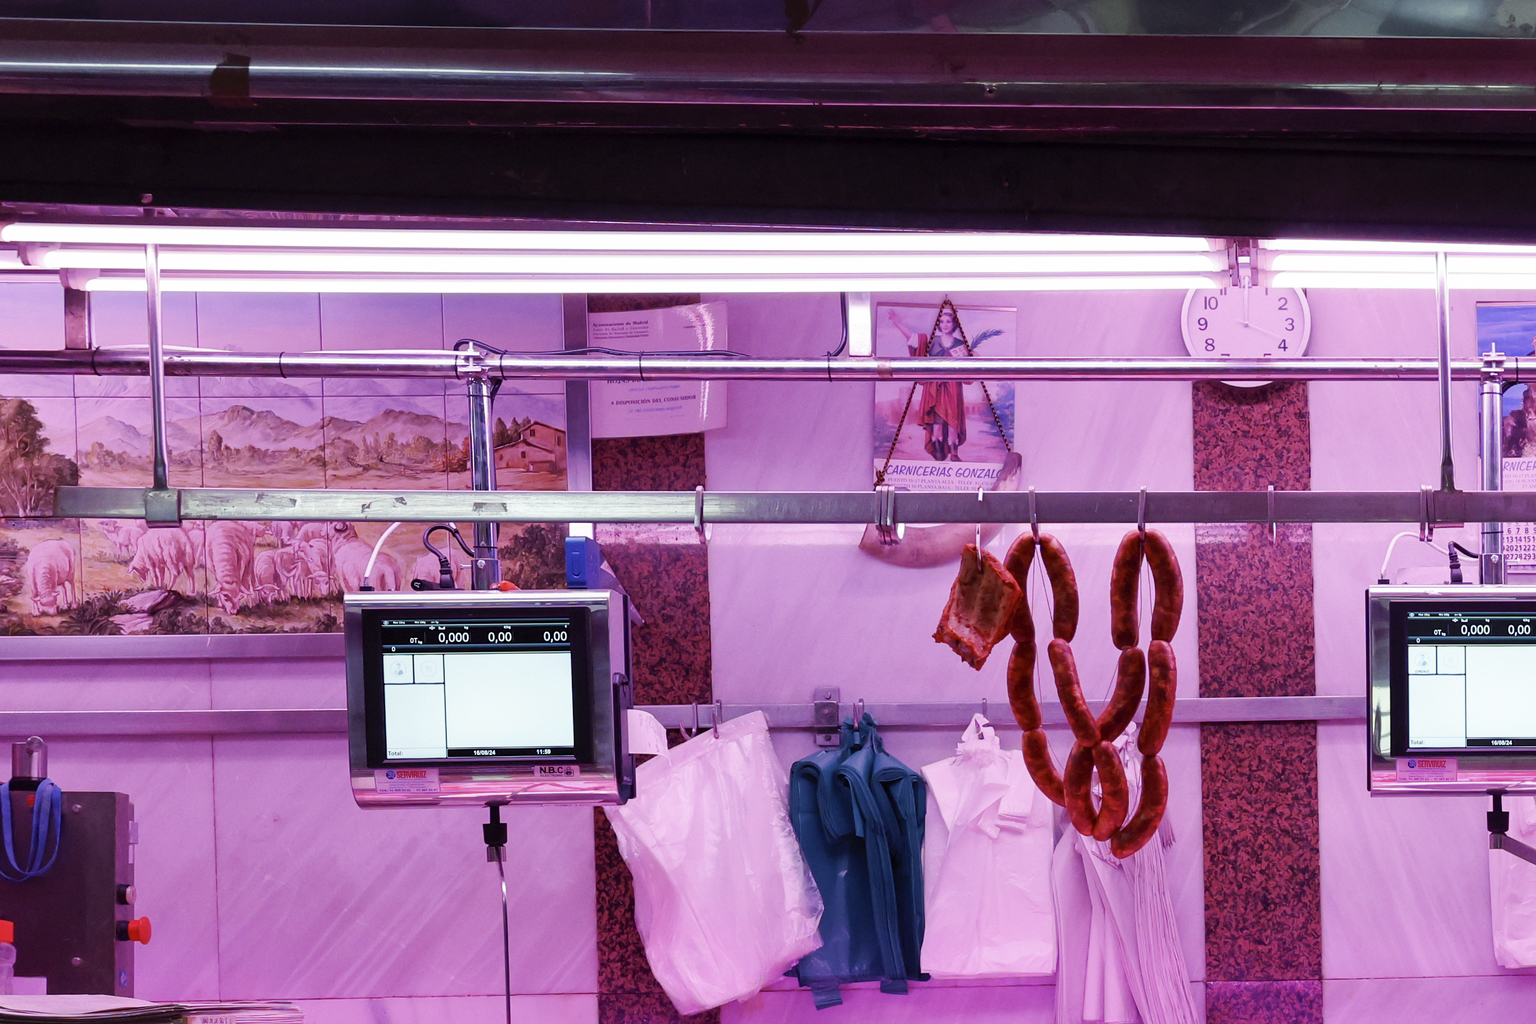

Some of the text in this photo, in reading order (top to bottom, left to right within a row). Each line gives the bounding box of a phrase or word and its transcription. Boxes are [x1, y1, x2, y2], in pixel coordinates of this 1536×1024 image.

[1204, 296, 1218, 310] 10
[1278, 297, 1288, 310] 2
[1198, 317, 1208, 331] 9
[1285, 318, 1294, 331] 3
[1205, 338, 1215, 351] 8
[1278, 339, 1288, 351] 4
[886, 464, 954, 478] CARNICERIAS
[1460, 625, 1490, 636] 0,000
[1508, 625, 1531, 636] 0,00
[438, 631, 568, 644] 0,000 0,00 0,00
[1418, 760, 1446, 768] SERVIRUIZ
[396, 770, 427, 778] SERVIRUIZ
